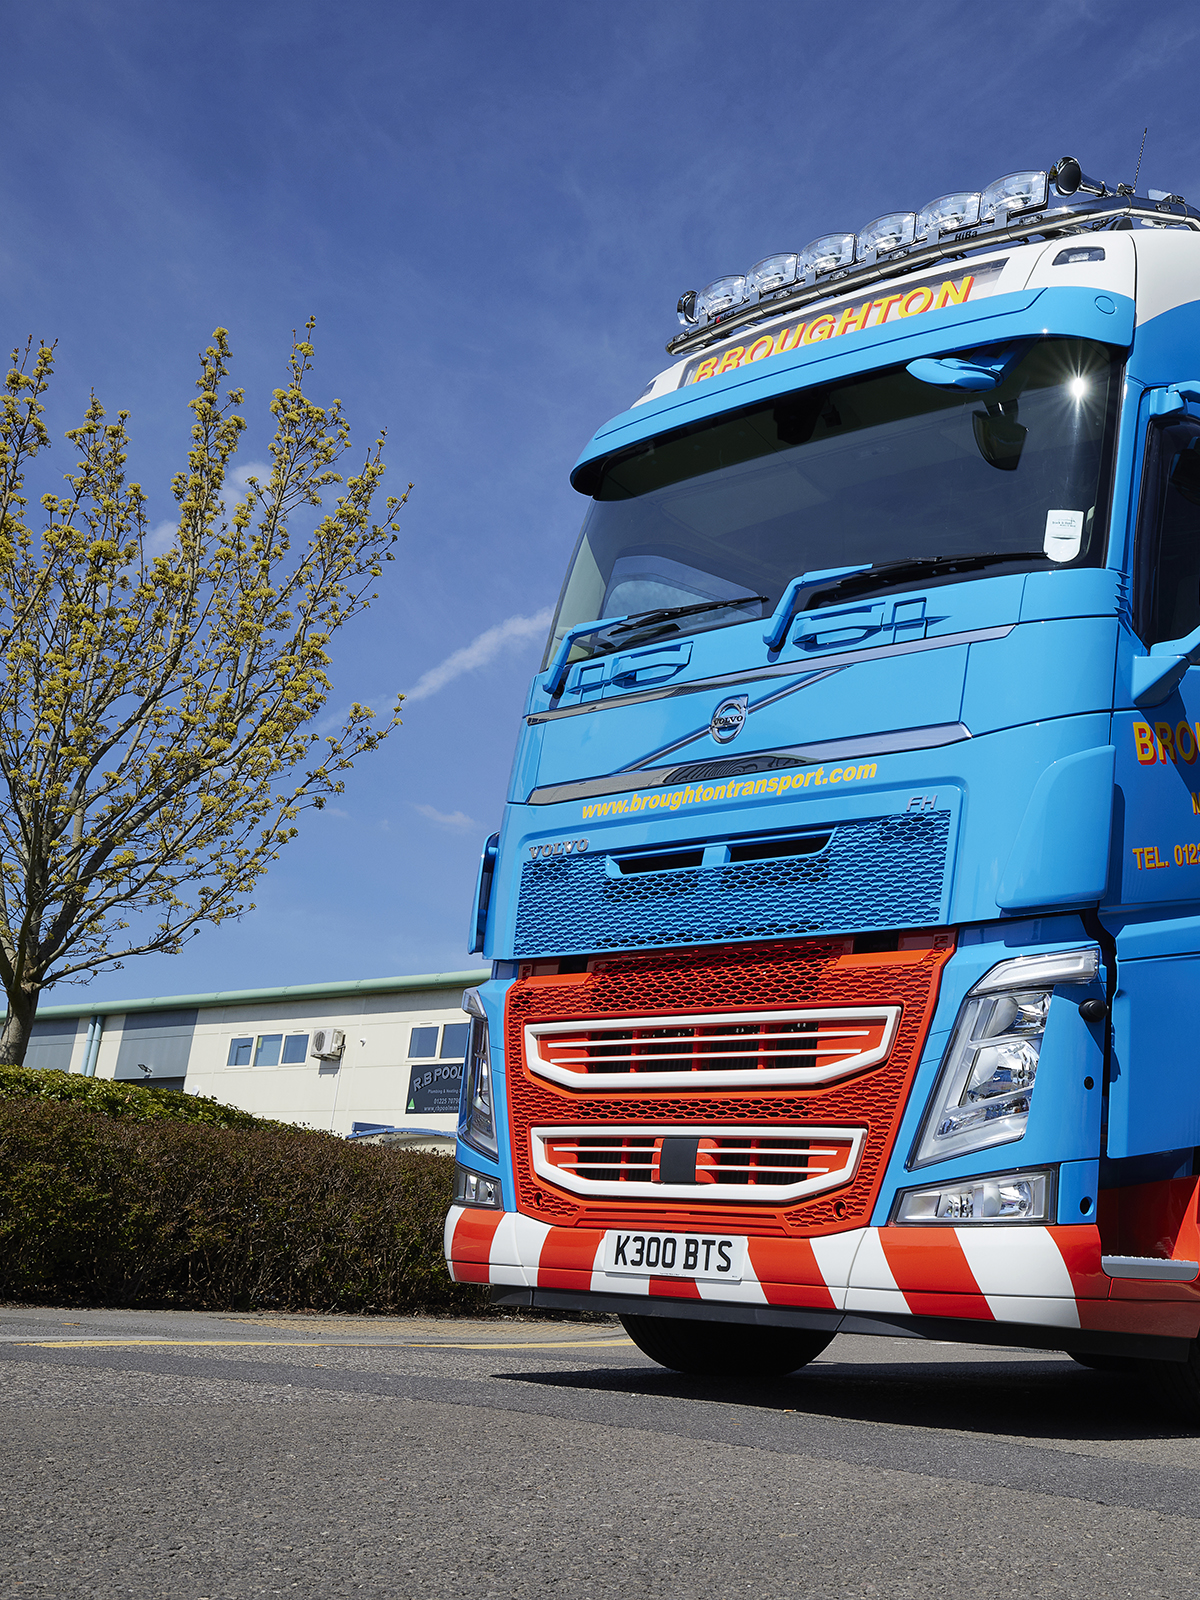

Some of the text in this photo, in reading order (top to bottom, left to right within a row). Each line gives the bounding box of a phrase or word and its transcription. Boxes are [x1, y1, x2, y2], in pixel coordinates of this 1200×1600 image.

[693, 276, 975, 384] BROUGHTON
[713, 715, 744, 726] VOLVO
[582, 763, 877, 819] www.broughtontransport.com
[906, 795, 938, 812] FH
[529, 838, 589, 859] VOLVO
[1132, 846, 1170, 870] TEL.
[413, 1071, 433, 1092] R.B
[614, 1234, 733, 1273] K300 BTS
